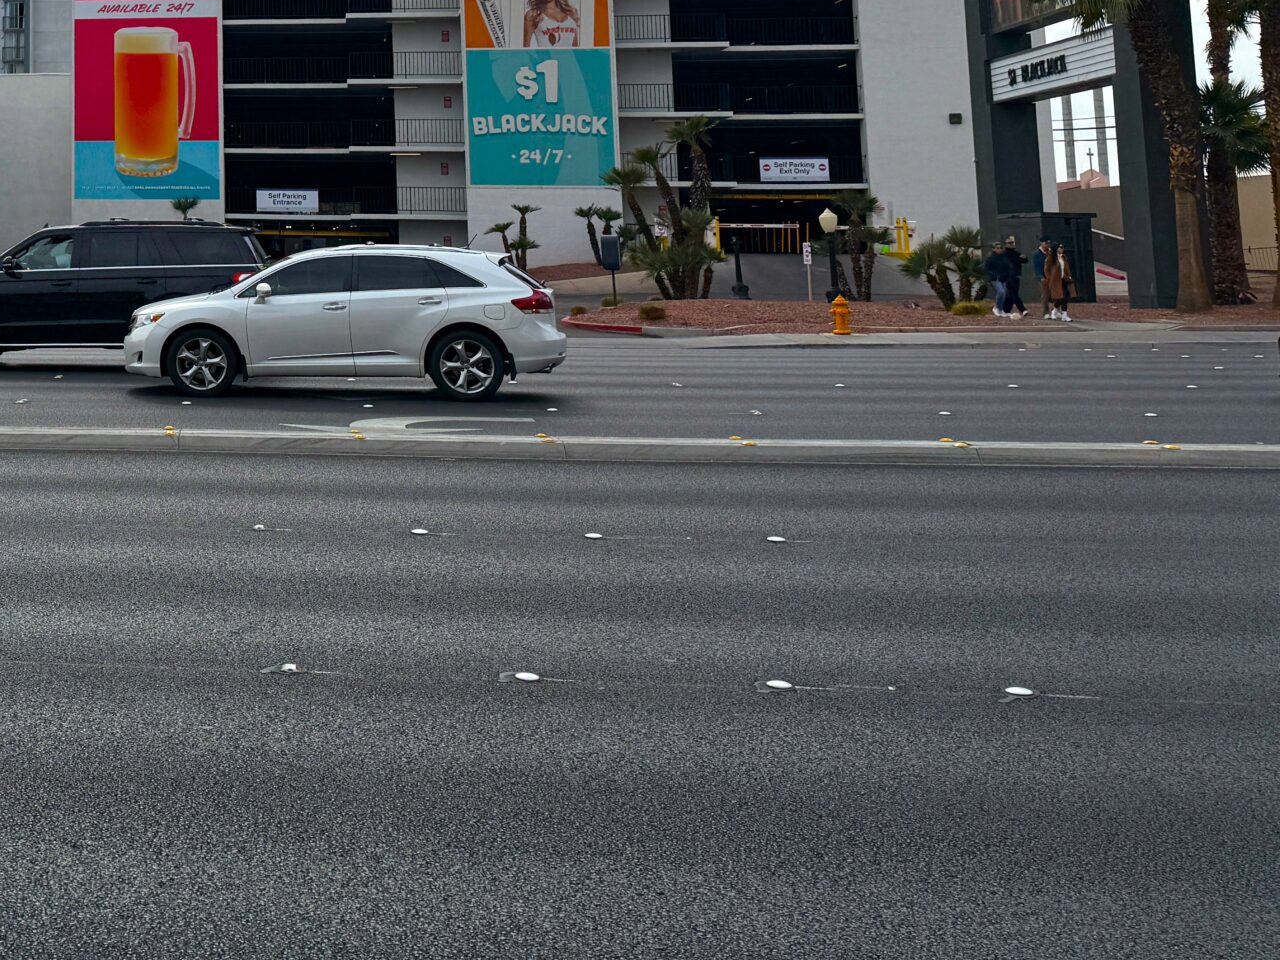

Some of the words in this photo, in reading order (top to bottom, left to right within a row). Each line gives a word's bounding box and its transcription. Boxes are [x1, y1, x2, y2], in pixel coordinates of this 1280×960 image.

[97, 3, 161, 14] AVAILABLE
[166, 2, 195, 15] 24/7
[515, 59, 558, 103] $1
[472, 113, 608, 135] BLACKJACK
[520, 148, 564, 165] 24/7
[789, 161, 815, 169] Parking
